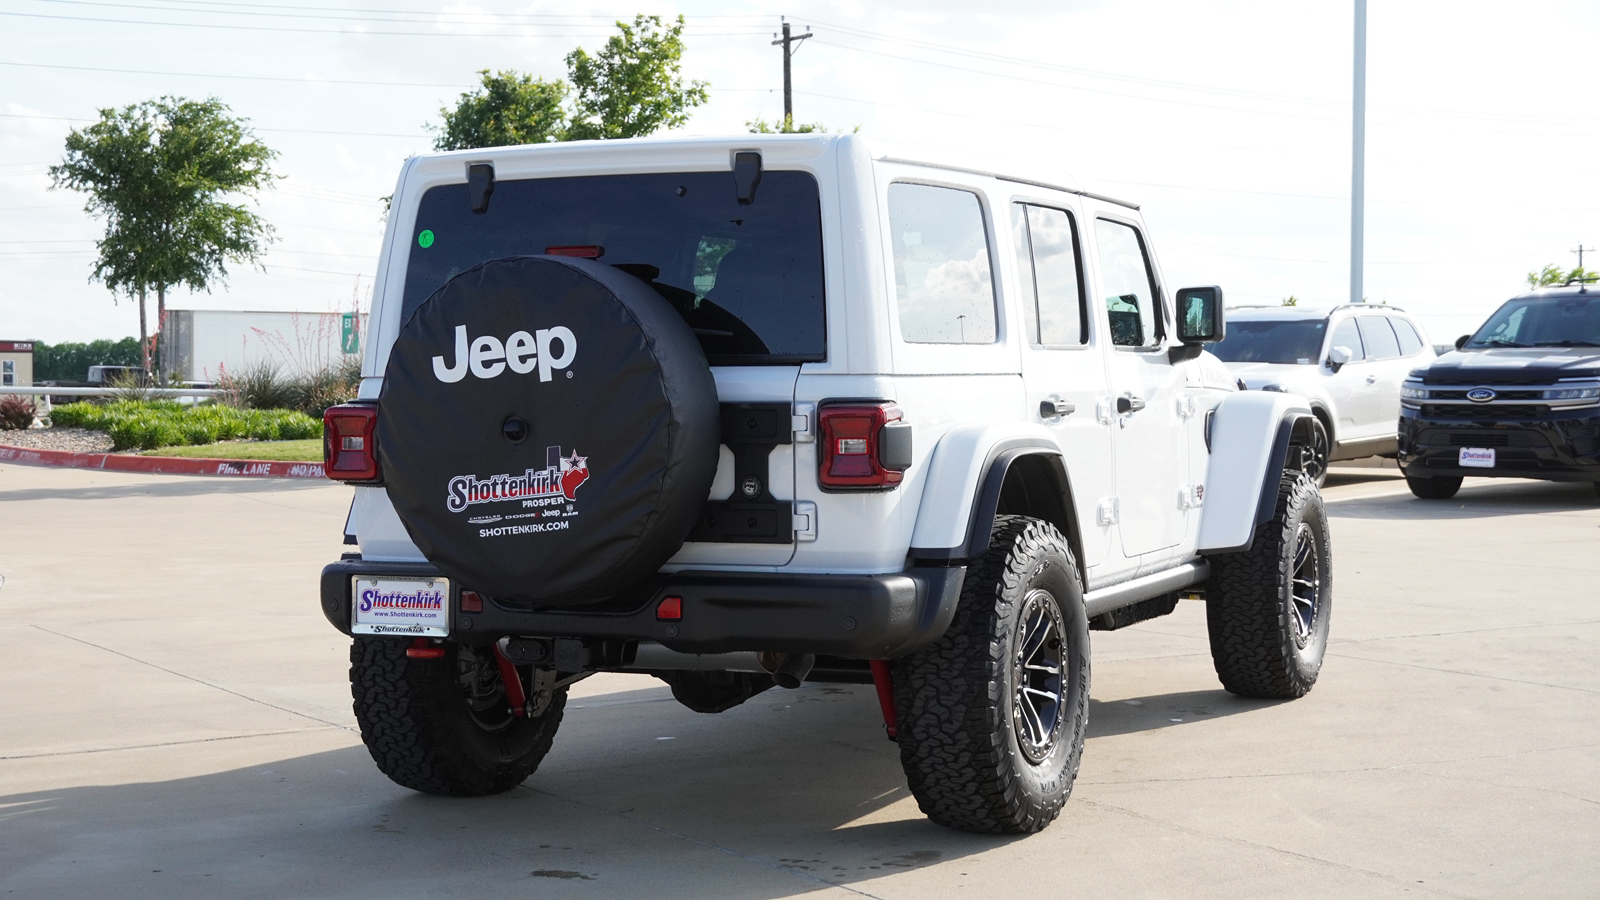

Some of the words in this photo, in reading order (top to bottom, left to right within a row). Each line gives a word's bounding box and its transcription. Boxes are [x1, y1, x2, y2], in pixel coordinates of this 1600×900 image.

[432, 324, 577, 383] Jeep
[1472, 391, 1488, 399] Ford
[243, 463, 272, 475] LANE
[290, 464, 307, 477] NO
[448, 466, 563, 512] Shottenkirk
[522, 497, 565, 508] PROSPER
[541, 509, 560, 518] Jeep
[479, 521, 570, 537] SHOTTENKIRK.COM
[360, 588, 444, 613] Shottenkirk
[374, 611, 437, 619] www.Shottenkirk.com
